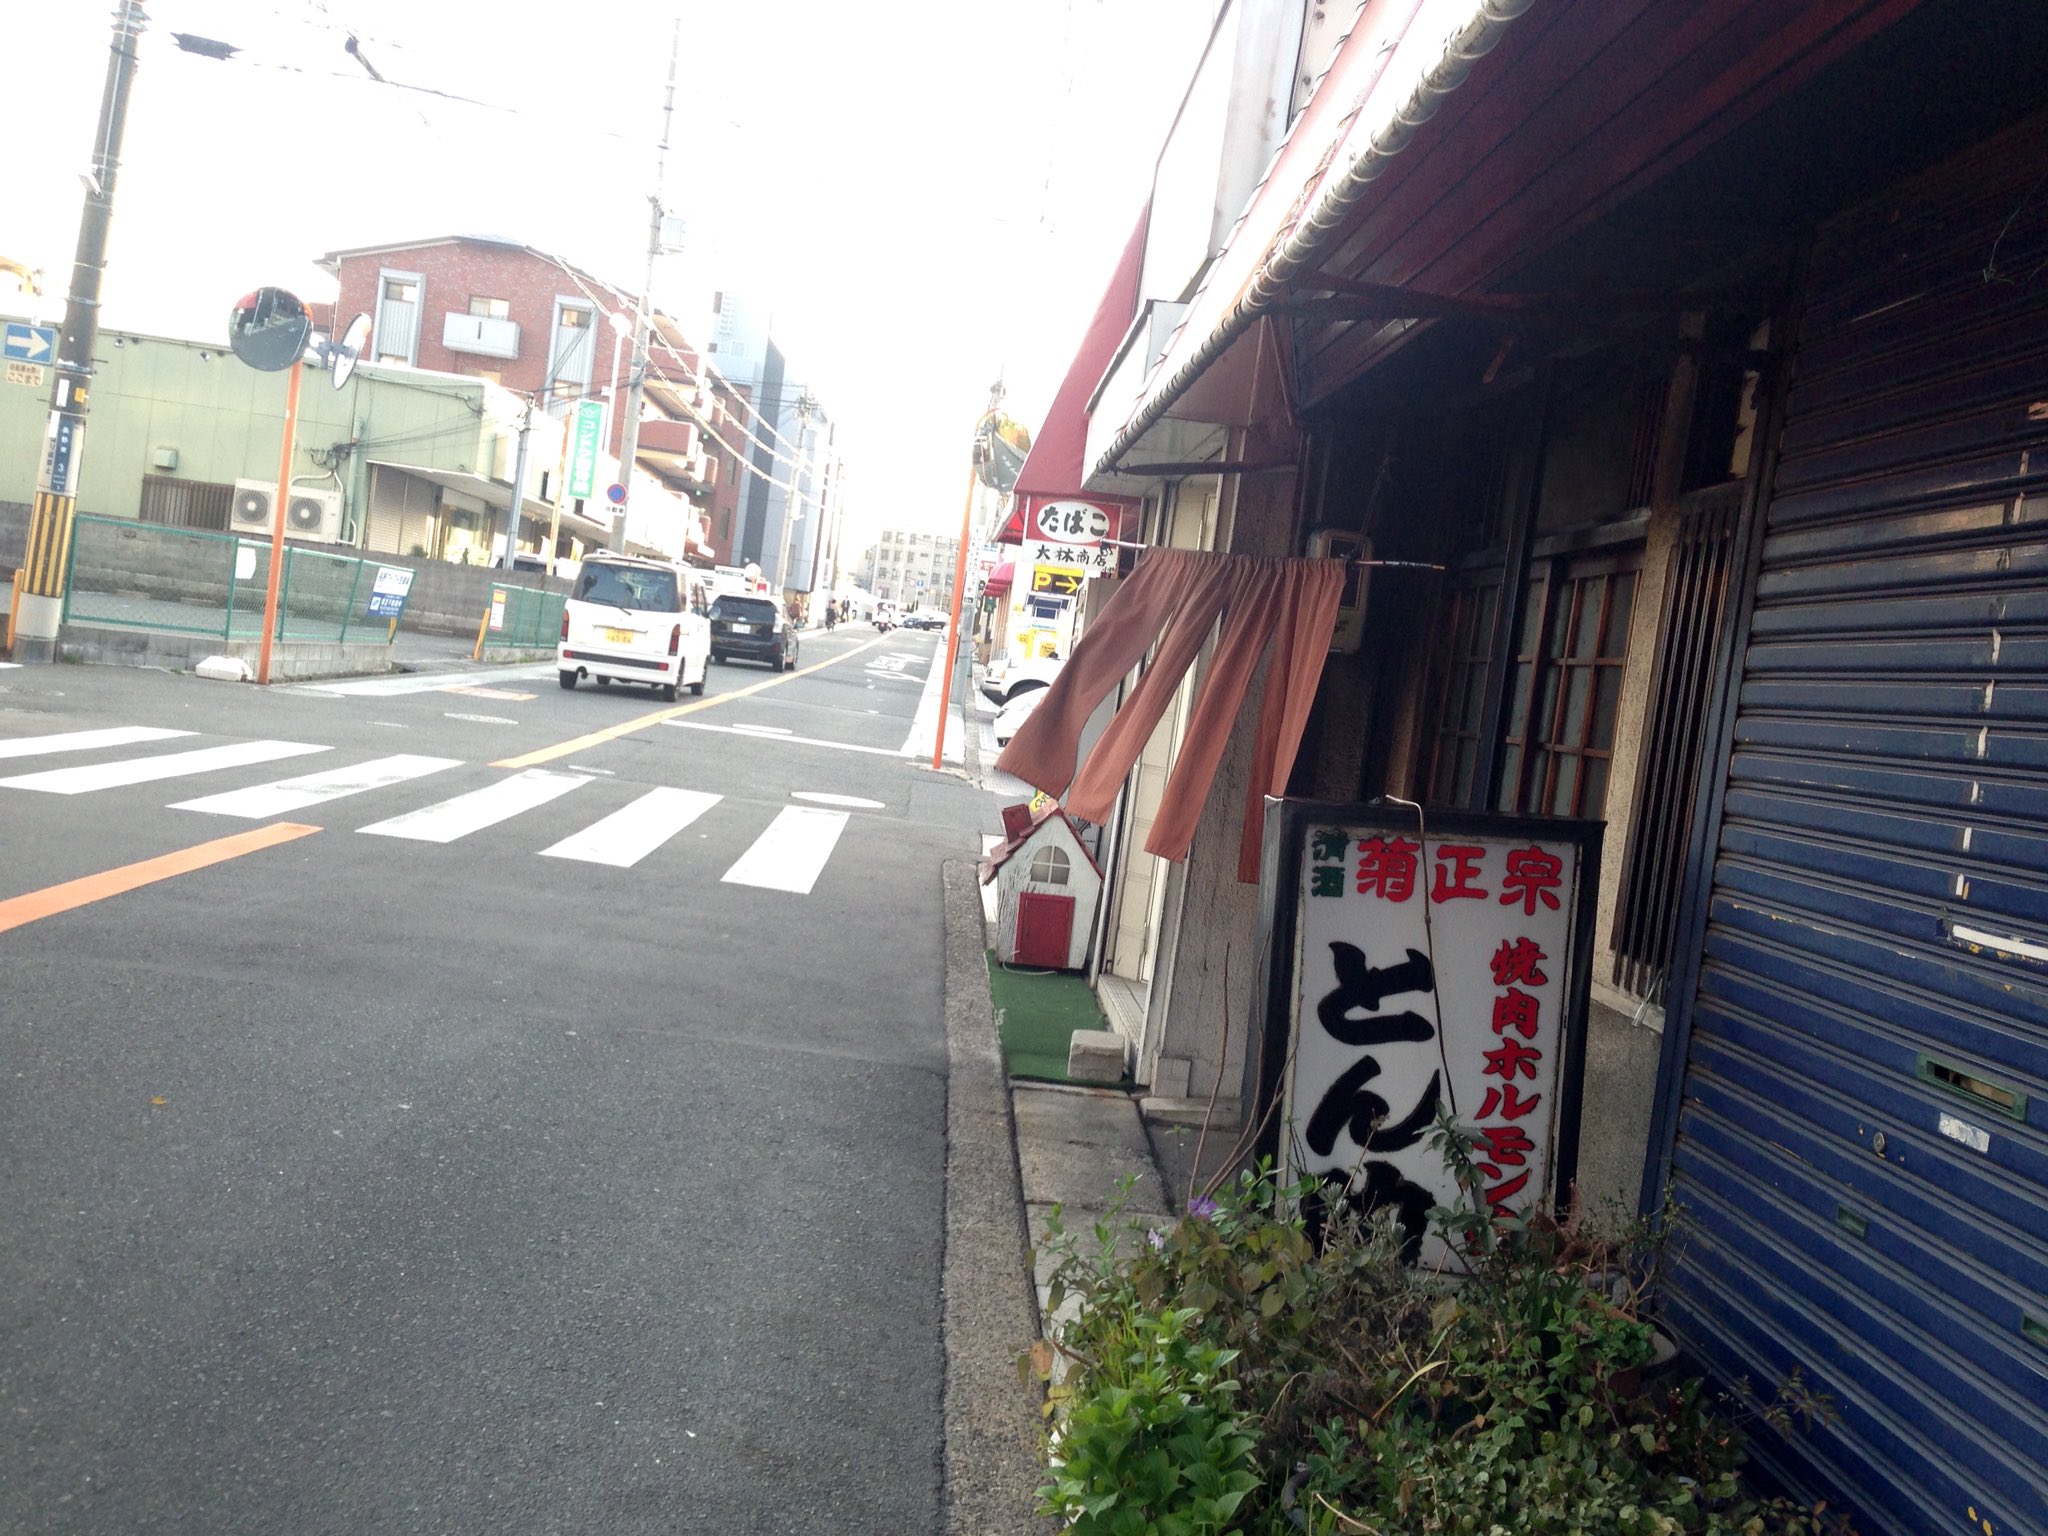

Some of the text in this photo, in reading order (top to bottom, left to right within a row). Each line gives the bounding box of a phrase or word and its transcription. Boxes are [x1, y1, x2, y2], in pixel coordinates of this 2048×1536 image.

[8, 373, 41, 385] ここまで
[1039, 506, 1107, 538] たばこ
[1035, 544, 1107, 567] 大林商店
[1033, 572, 1052, 591] P
[1356, 836, 1563, 916] 菊正宗
